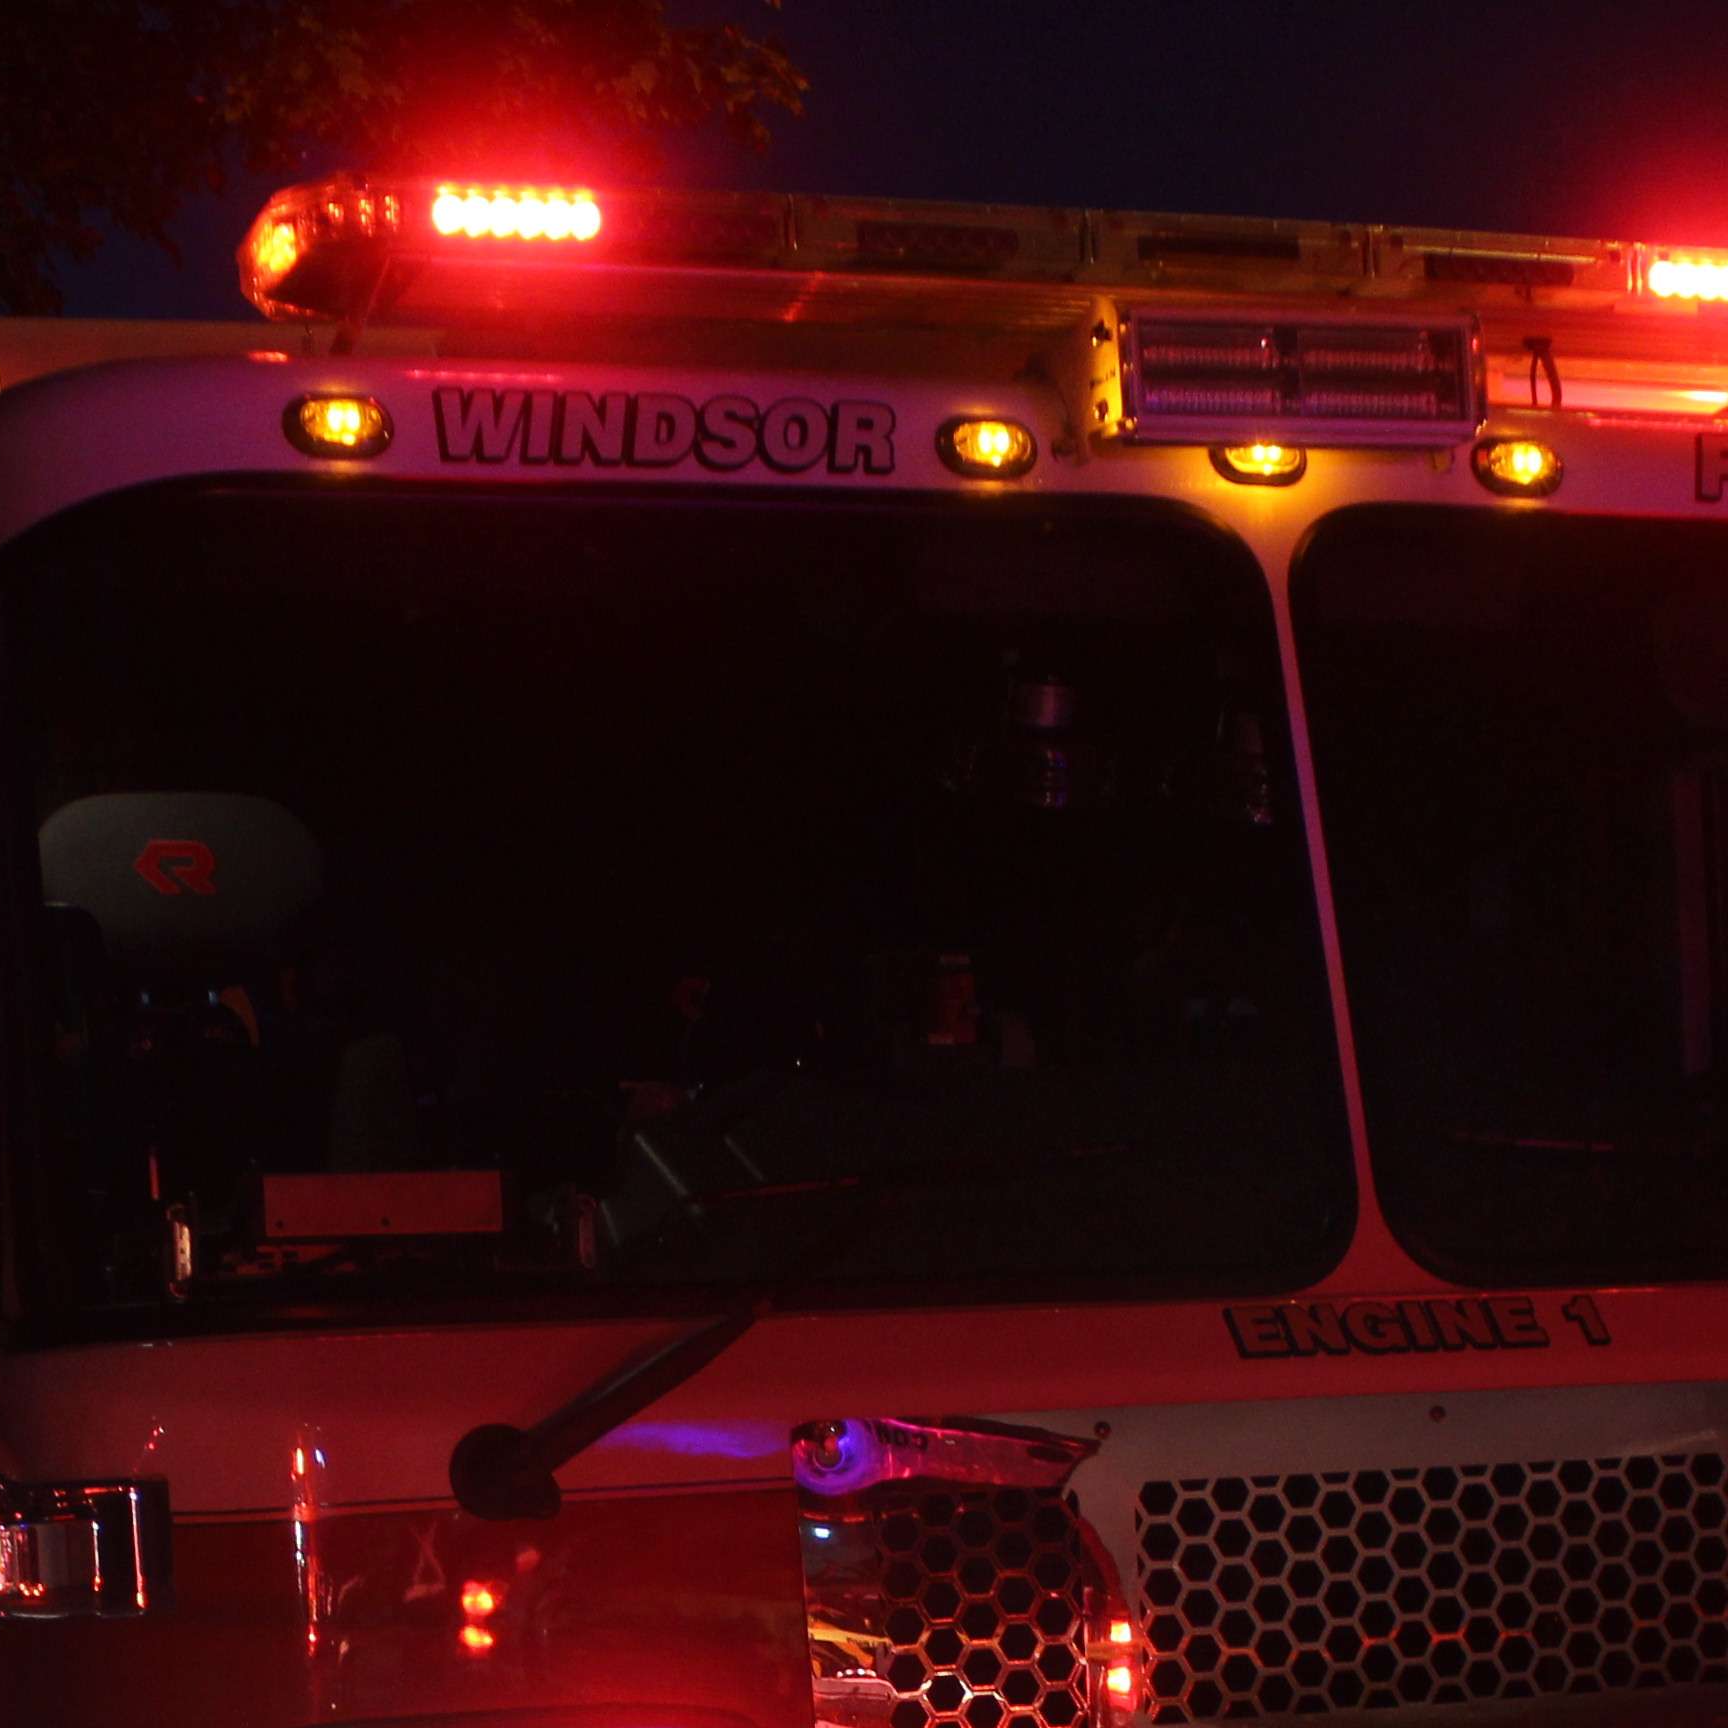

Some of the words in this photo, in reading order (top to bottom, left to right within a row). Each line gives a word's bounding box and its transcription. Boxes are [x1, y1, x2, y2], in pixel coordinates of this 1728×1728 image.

[432, 386, 896, 473] WINDSOR
[1223, 1296, 1551, 1359] ENGINE
[1562, 1294, 1612, 1347] 1
